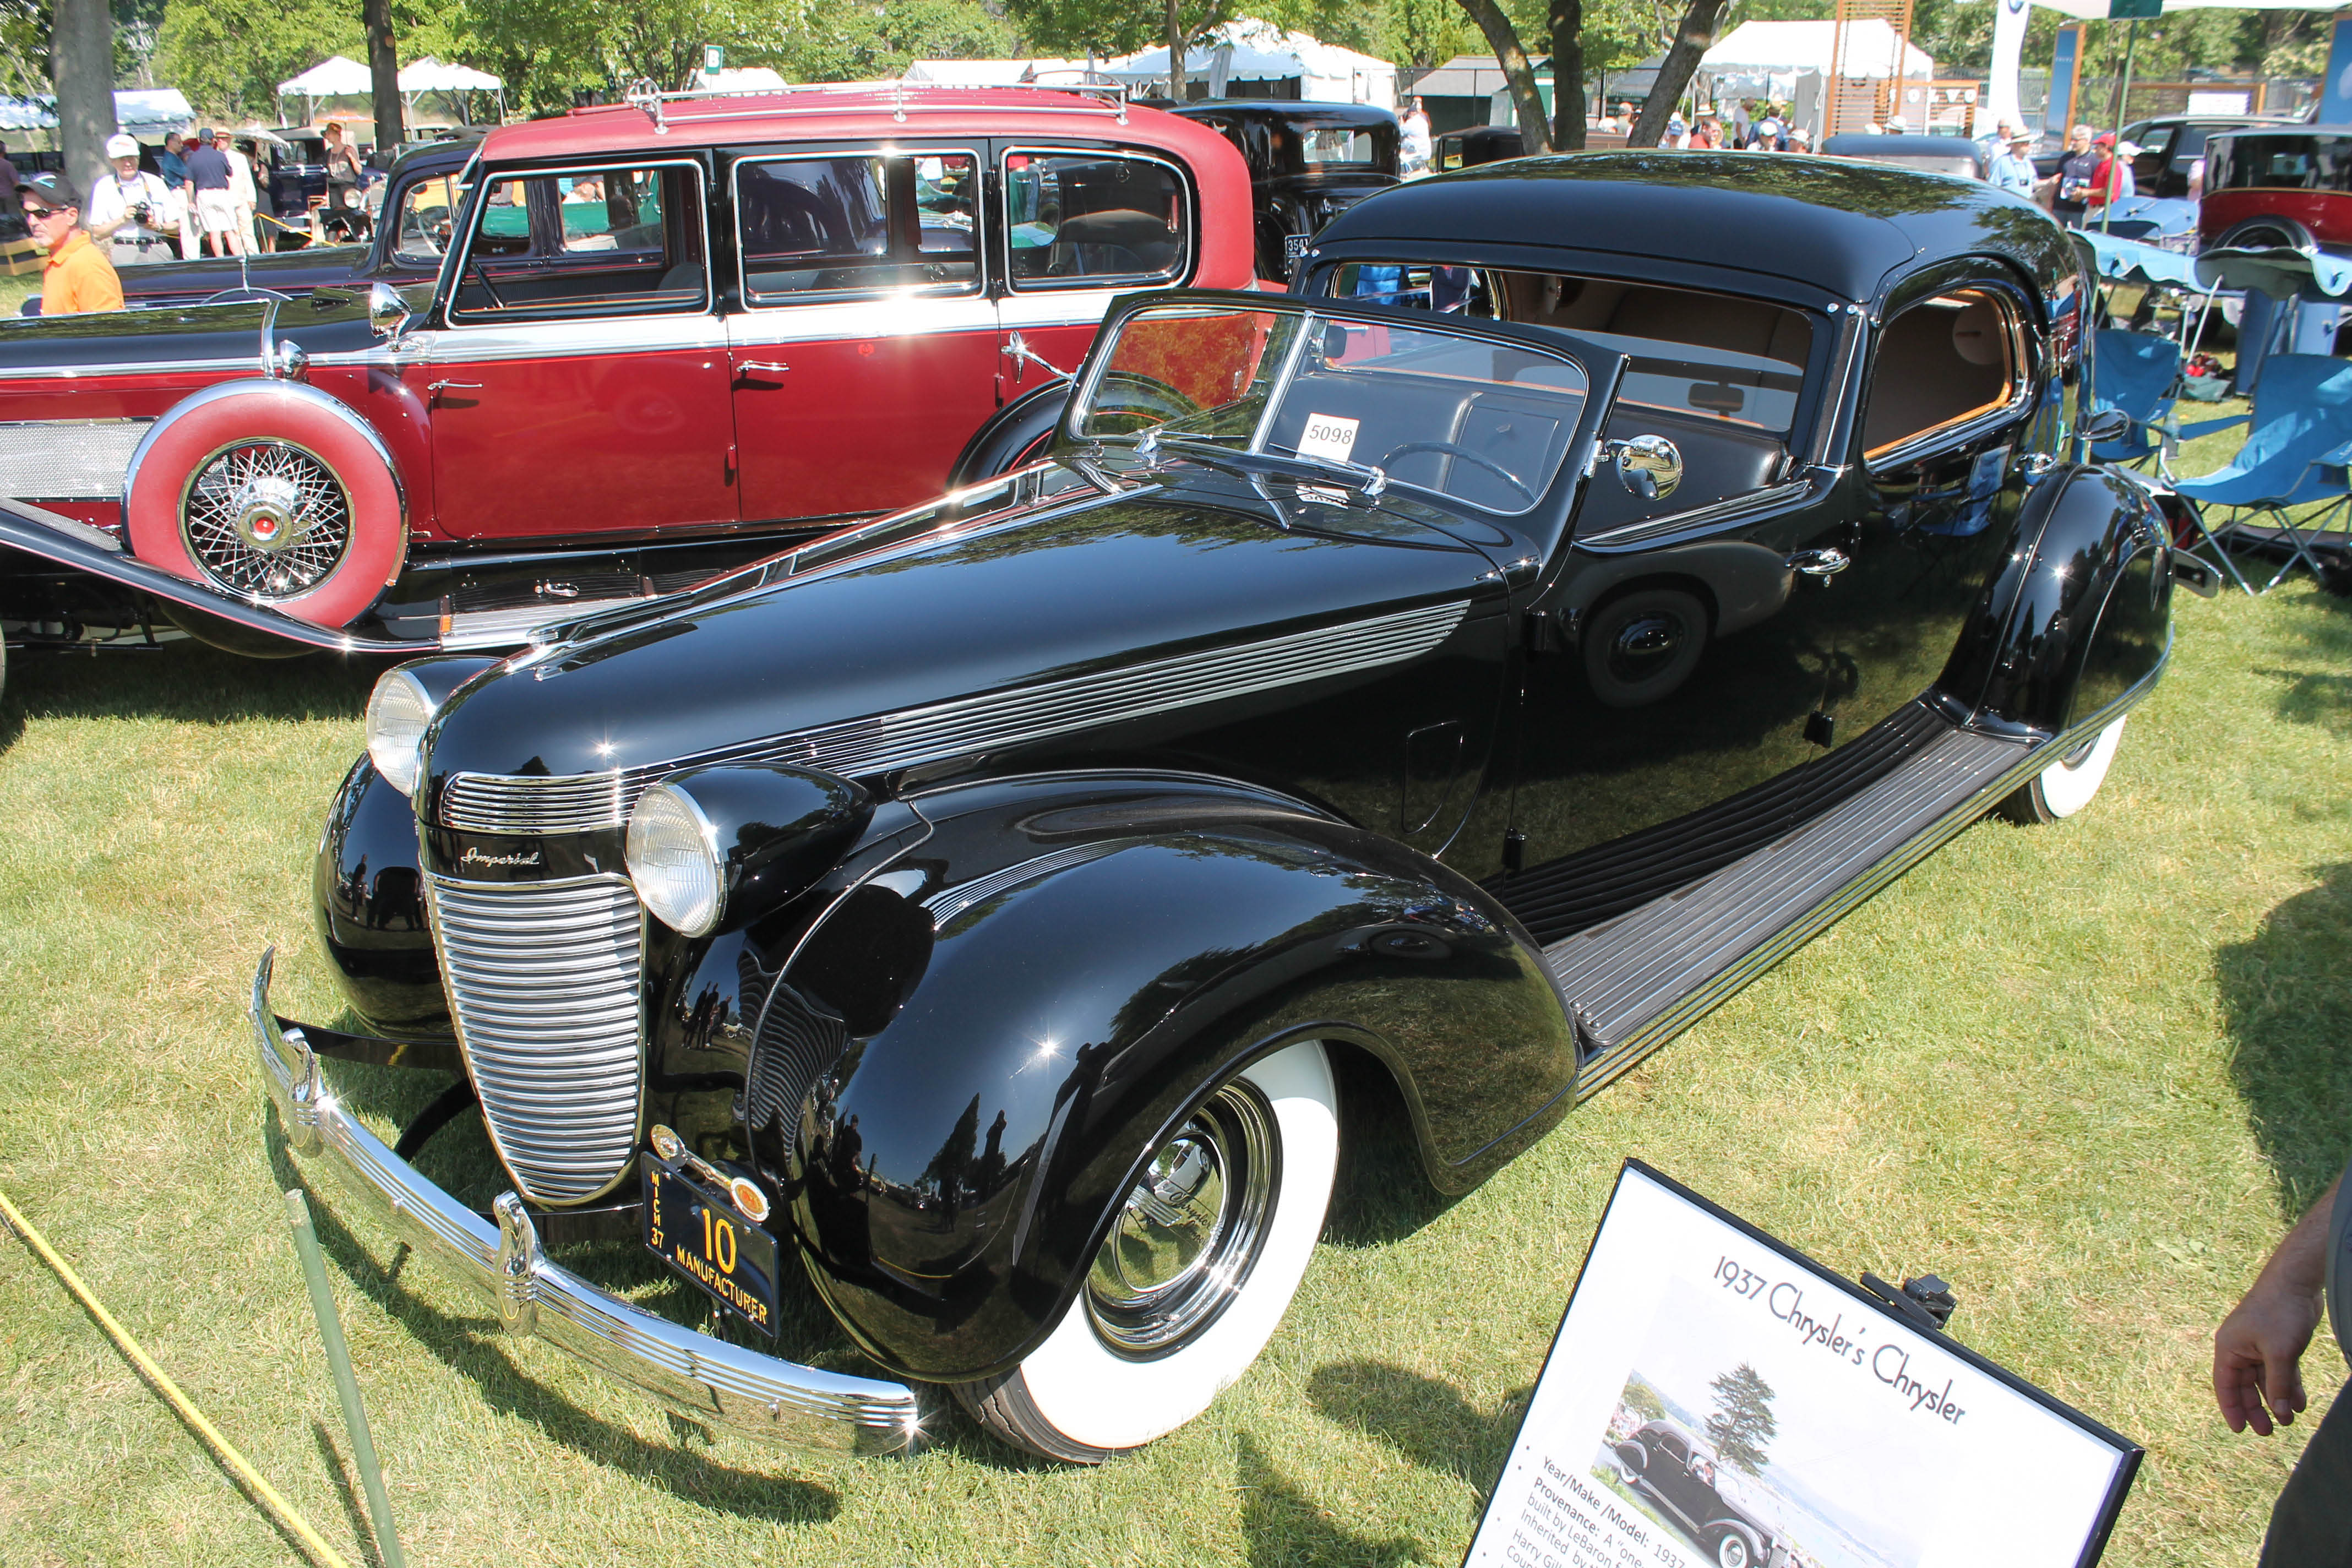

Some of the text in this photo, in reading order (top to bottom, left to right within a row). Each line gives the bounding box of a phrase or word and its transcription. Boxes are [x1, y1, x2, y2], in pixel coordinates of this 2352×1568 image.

[708, 50, 720, 68] B
[1309, 425, 1353, 444] 5098
[460, 847, 540, 868] Imperial
[650, 1170, 661, 1227] MICH
[651, 1227, 664, 1249] 37
[702, 1208, 737, 1275] 10
[677, 1244, 767, 1325] MANUFACTURER
[1713, 1255, 1966, 1425] 1937 Chrysler's Chrysler
[1527, 1491, 1612, 1568] built by LeBaron
[1534, 1477, 1600, 1537] Provenance:
[1603, 1533, 1612, 1548] A
[1543, 1455, 1600, 1510] Year/Make
[1600, 1504, 1649, 1548] /Model:
[1512, 1528, 1542, 1561] Harry
[1521, 1508, 1587, 1568] Inherited by
